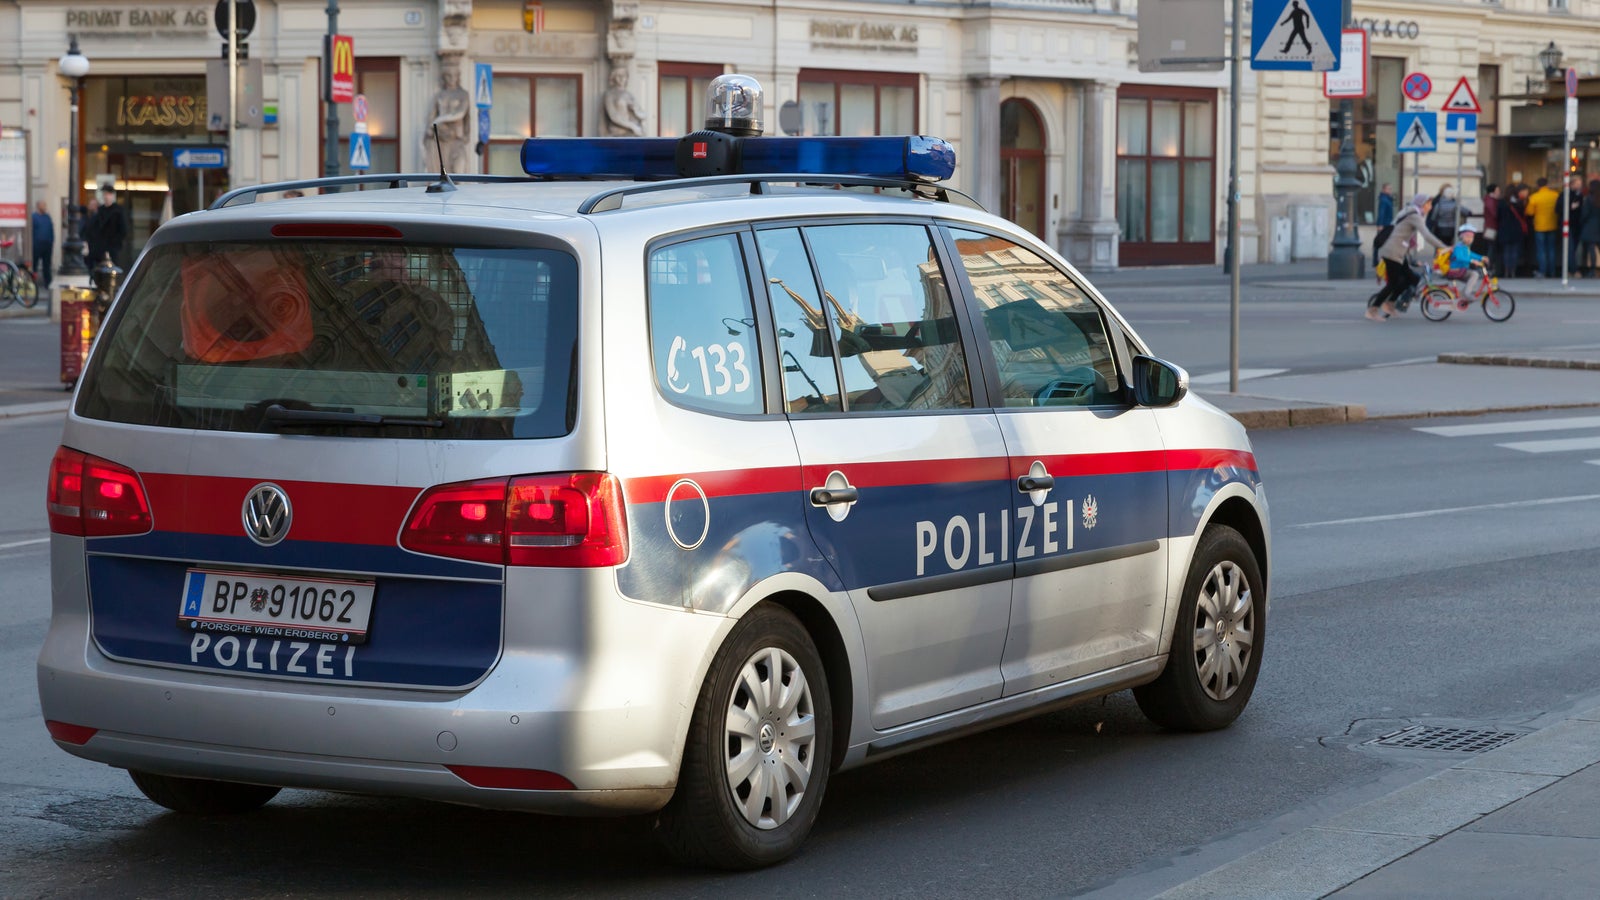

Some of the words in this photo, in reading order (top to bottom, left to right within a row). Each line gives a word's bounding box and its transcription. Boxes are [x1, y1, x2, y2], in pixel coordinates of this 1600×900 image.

[67, 10, 122, 26] PRIVAT
[129, 11, 176, 26] BANK
[184, 12, 208, 27] AG
[809, 20, 856, 38] PRIVAT
[859, 22, 896, 41] BANK
[900, 24, 919, 42] AG
[1397, 20, 1419, 40] CO
[117, 95, 207, 126] KASSE
[691, 341, 751, 396] 133
[916, 500, 1074, 576] POLIZEI
[212, 580, 249, 614] BP
[268, 584, 356, 623] 91062
[200, 621, 251, 633] PORSCHE
[254, 626, 282, 636] WIEN
[284, 628, 338, 641] ERDBERG
[190, 632, 356, 677] POLIZEI
